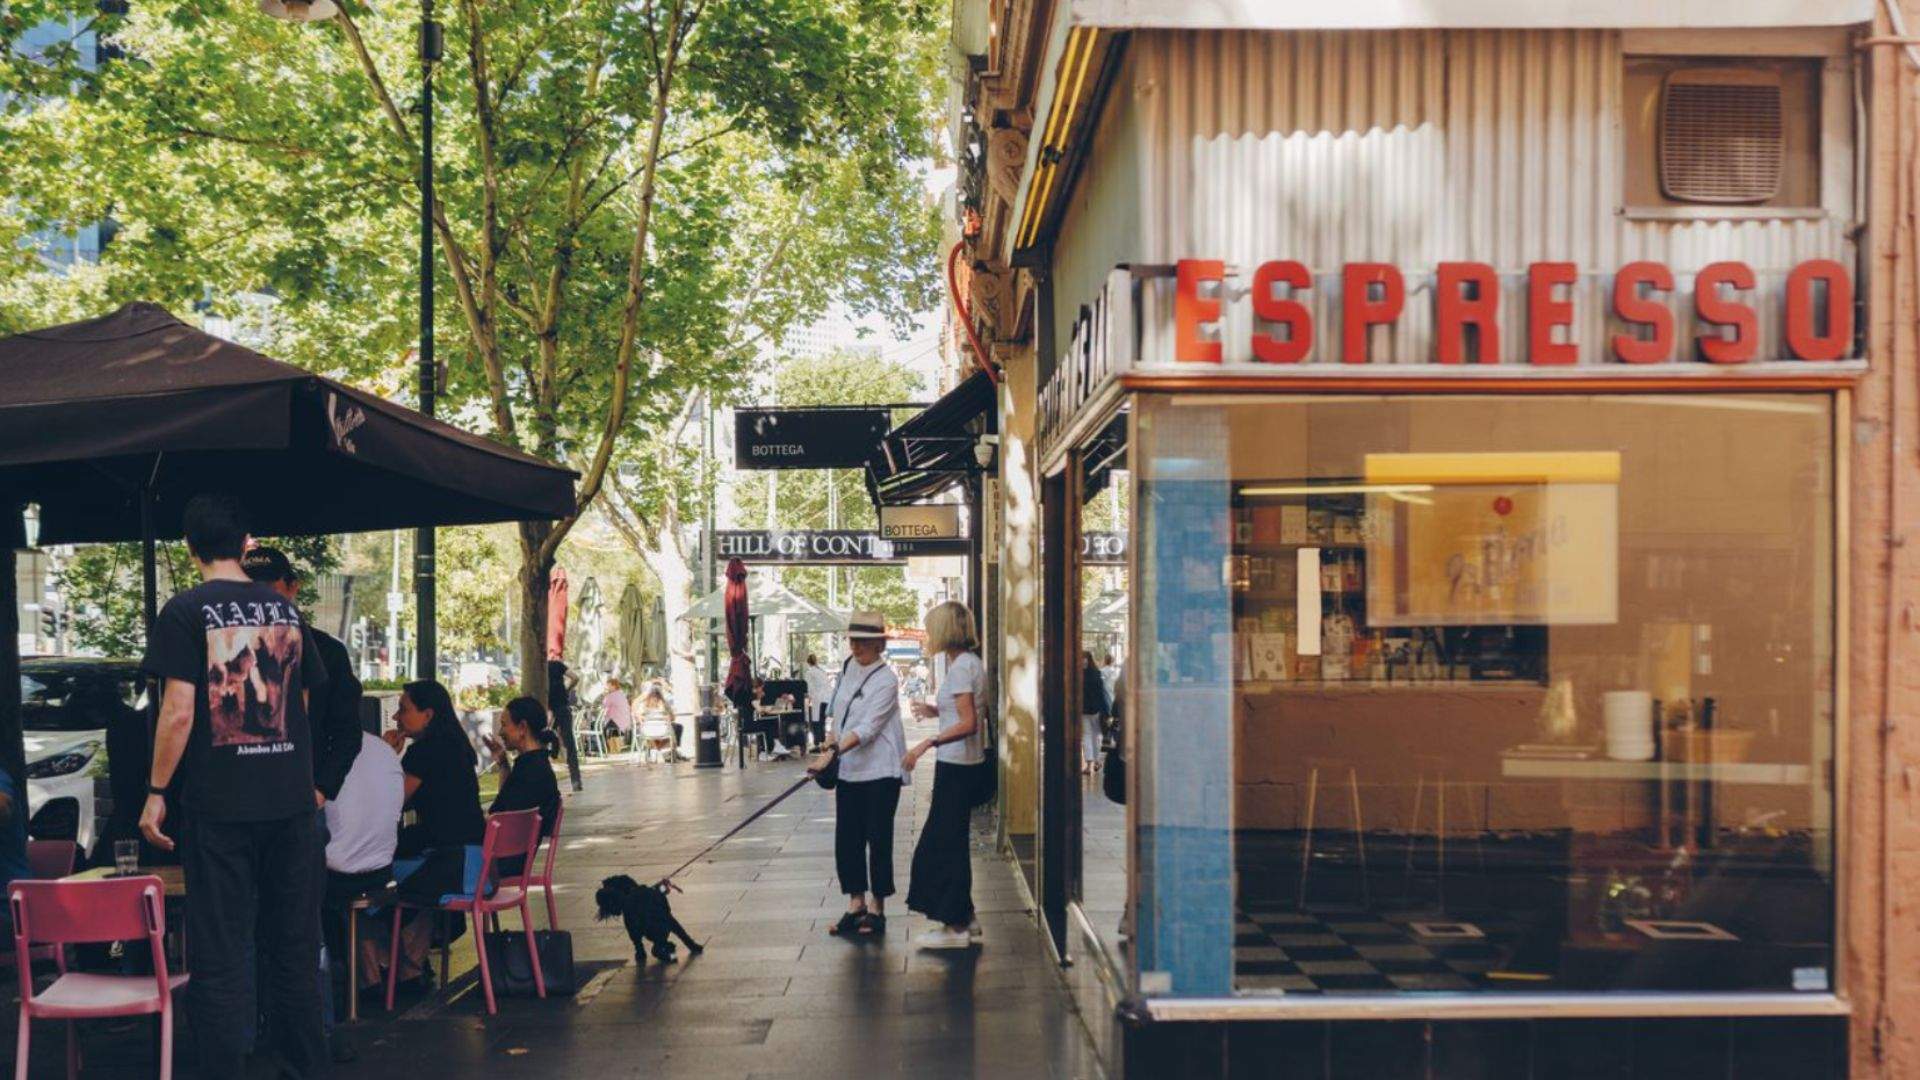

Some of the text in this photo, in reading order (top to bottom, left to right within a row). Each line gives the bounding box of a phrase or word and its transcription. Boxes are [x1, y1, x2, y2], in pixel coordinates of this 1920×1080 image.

[1175, 258, 1852, 364] ESPRESSO
[752, 444, 805, 456] BOTTEGA
[884, 524, 939, 537] BOTTEGA
[719, 535, 771, 555] HILL
[777, 535, 807, 555] OF
[812, 535, 875, 555] CONT
